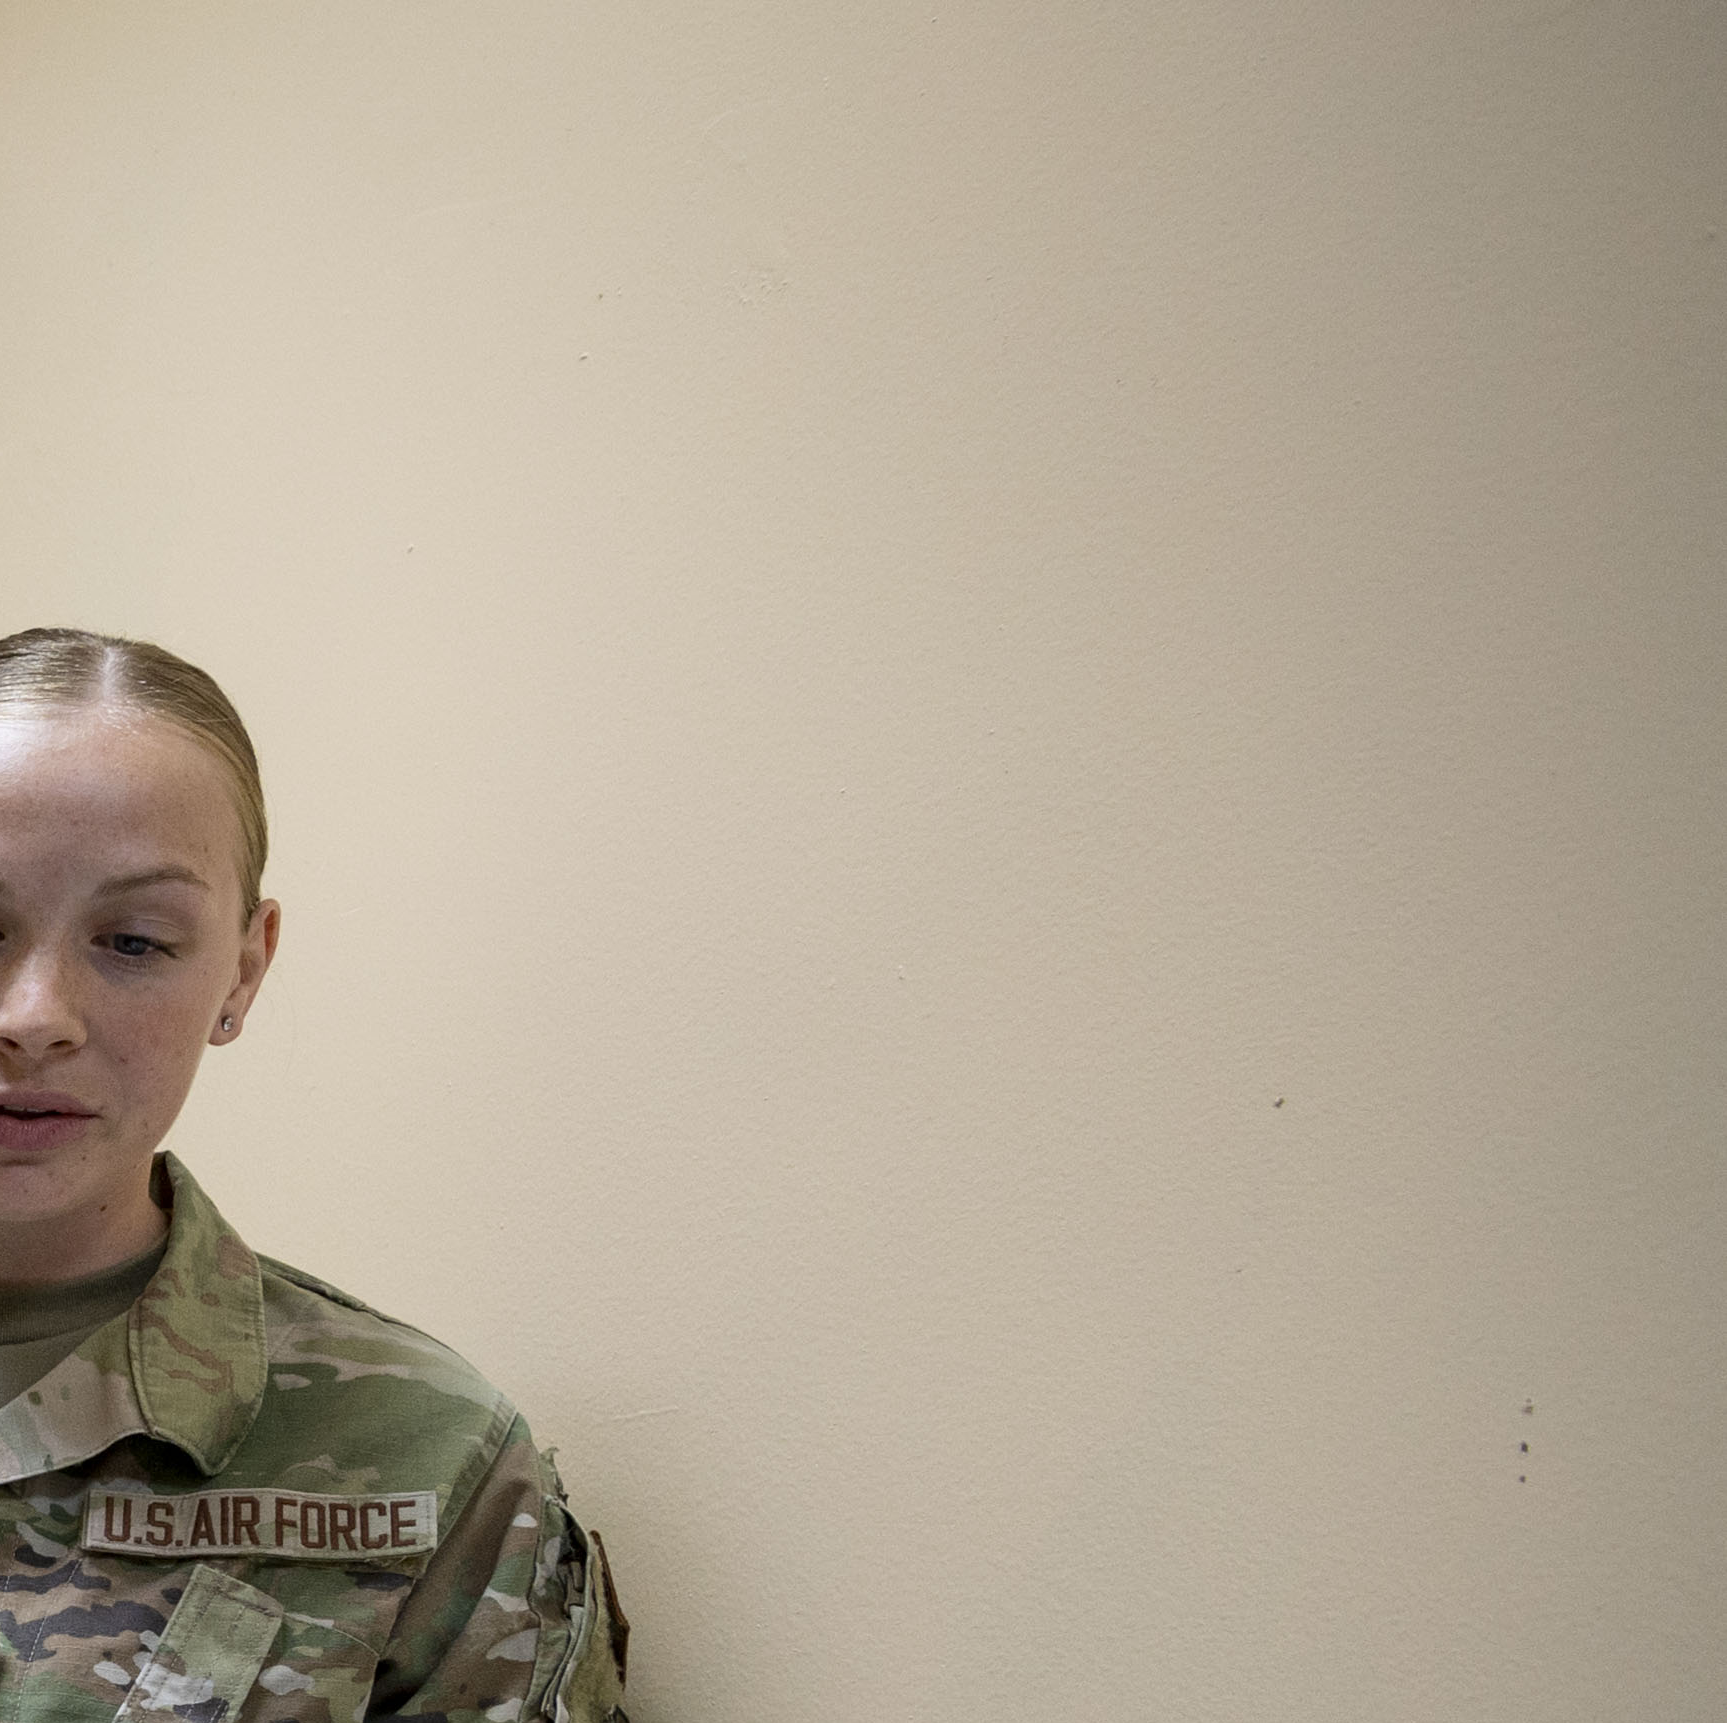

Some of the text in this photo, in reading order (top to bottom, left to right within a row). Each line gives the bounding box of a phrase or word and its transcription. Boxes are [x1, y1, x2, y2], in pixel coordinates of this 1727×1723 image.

[104, 1495, 417, 1551] U.S. AIR FORCE
